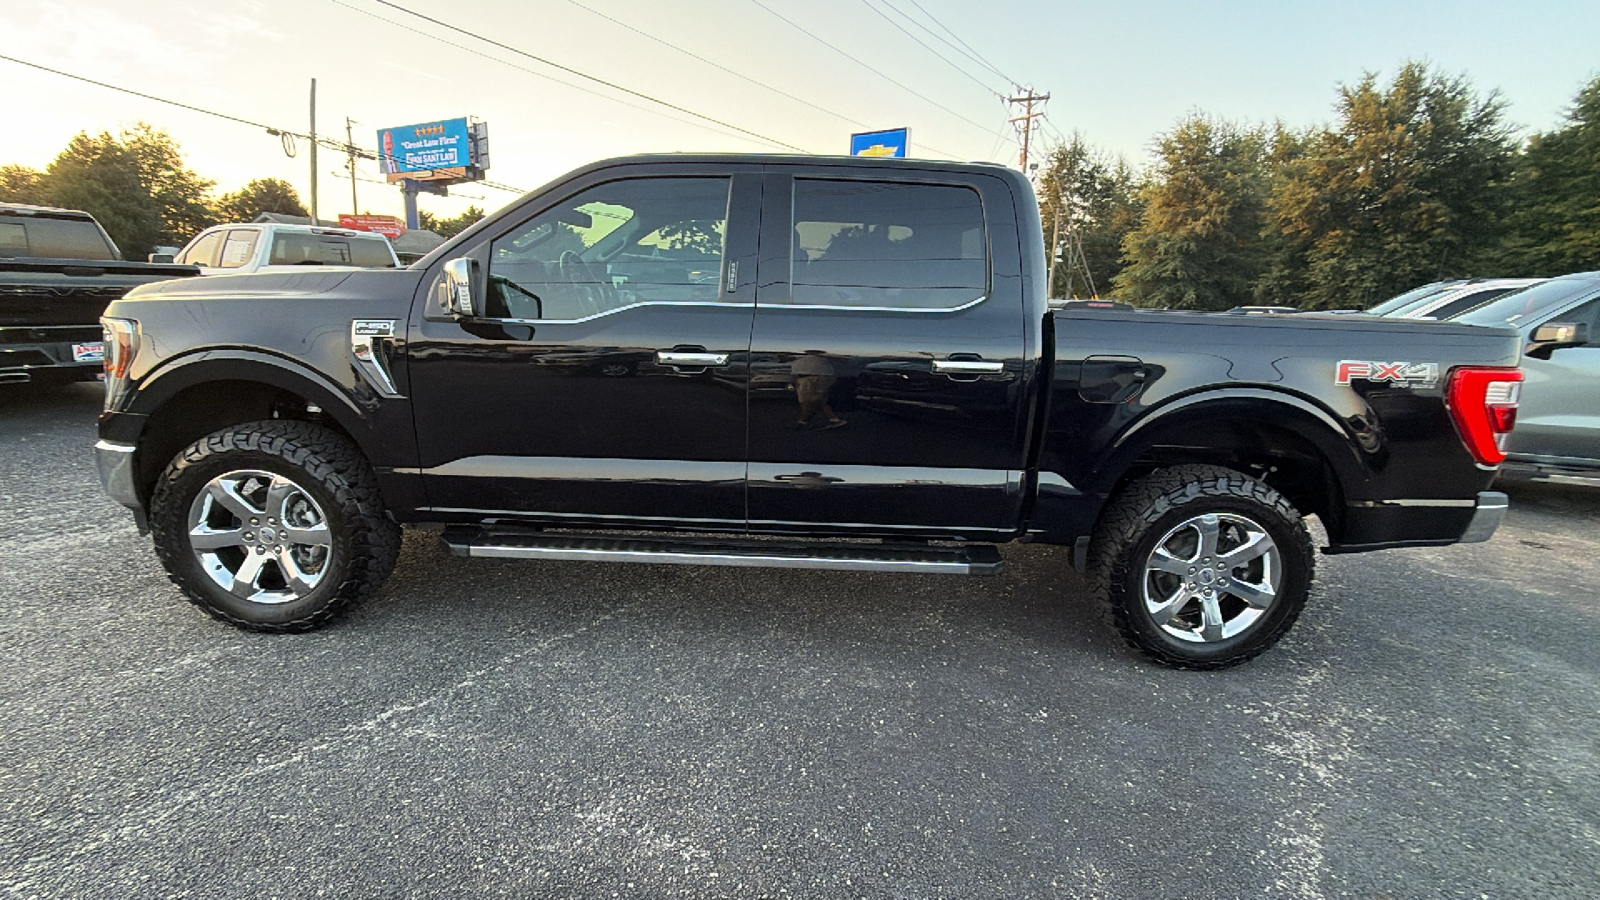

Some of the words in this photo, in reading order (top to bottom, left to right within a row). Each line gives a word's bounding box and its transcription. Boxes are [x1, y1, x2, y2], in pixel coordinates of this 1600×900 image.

[423, 139, 438, 147] Law
[423, 153, 440, 162] SANT
[440, 152, 454, 161] LAW
[1335, 360, 1438, 386] FX4
